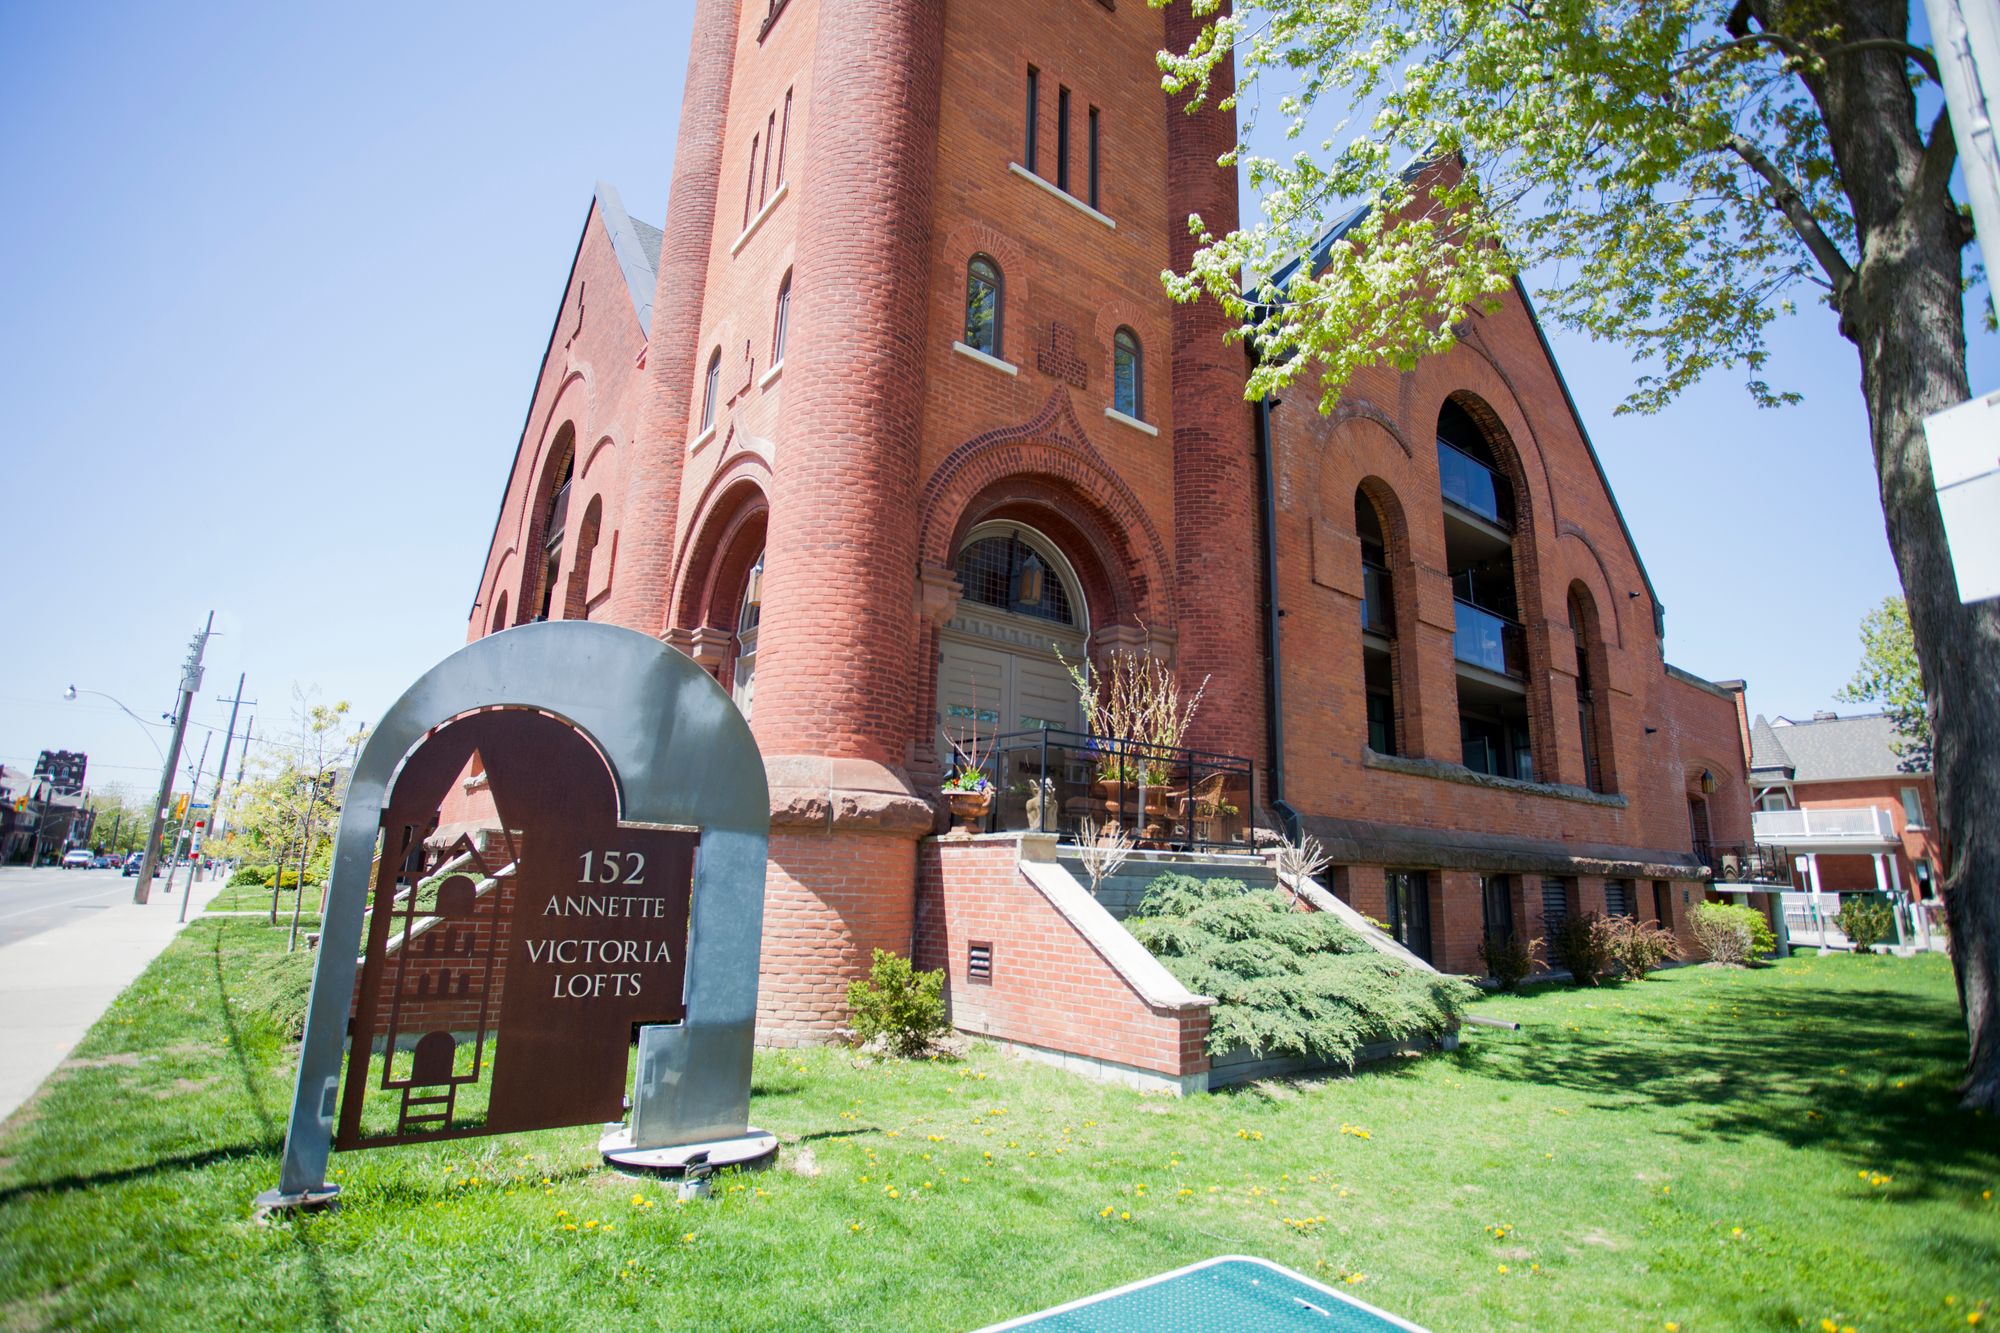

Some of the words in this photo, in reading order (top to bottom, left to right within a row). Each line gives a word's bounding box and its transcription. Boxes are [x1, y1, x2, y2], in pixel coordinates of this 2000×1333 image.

[577, 850, 646, 885] 152
[541, 895, 665, 918] ANNETTE
[525, 939, 672, 964] VICTORIA
[553, 972, 642, 998] LOFTS
